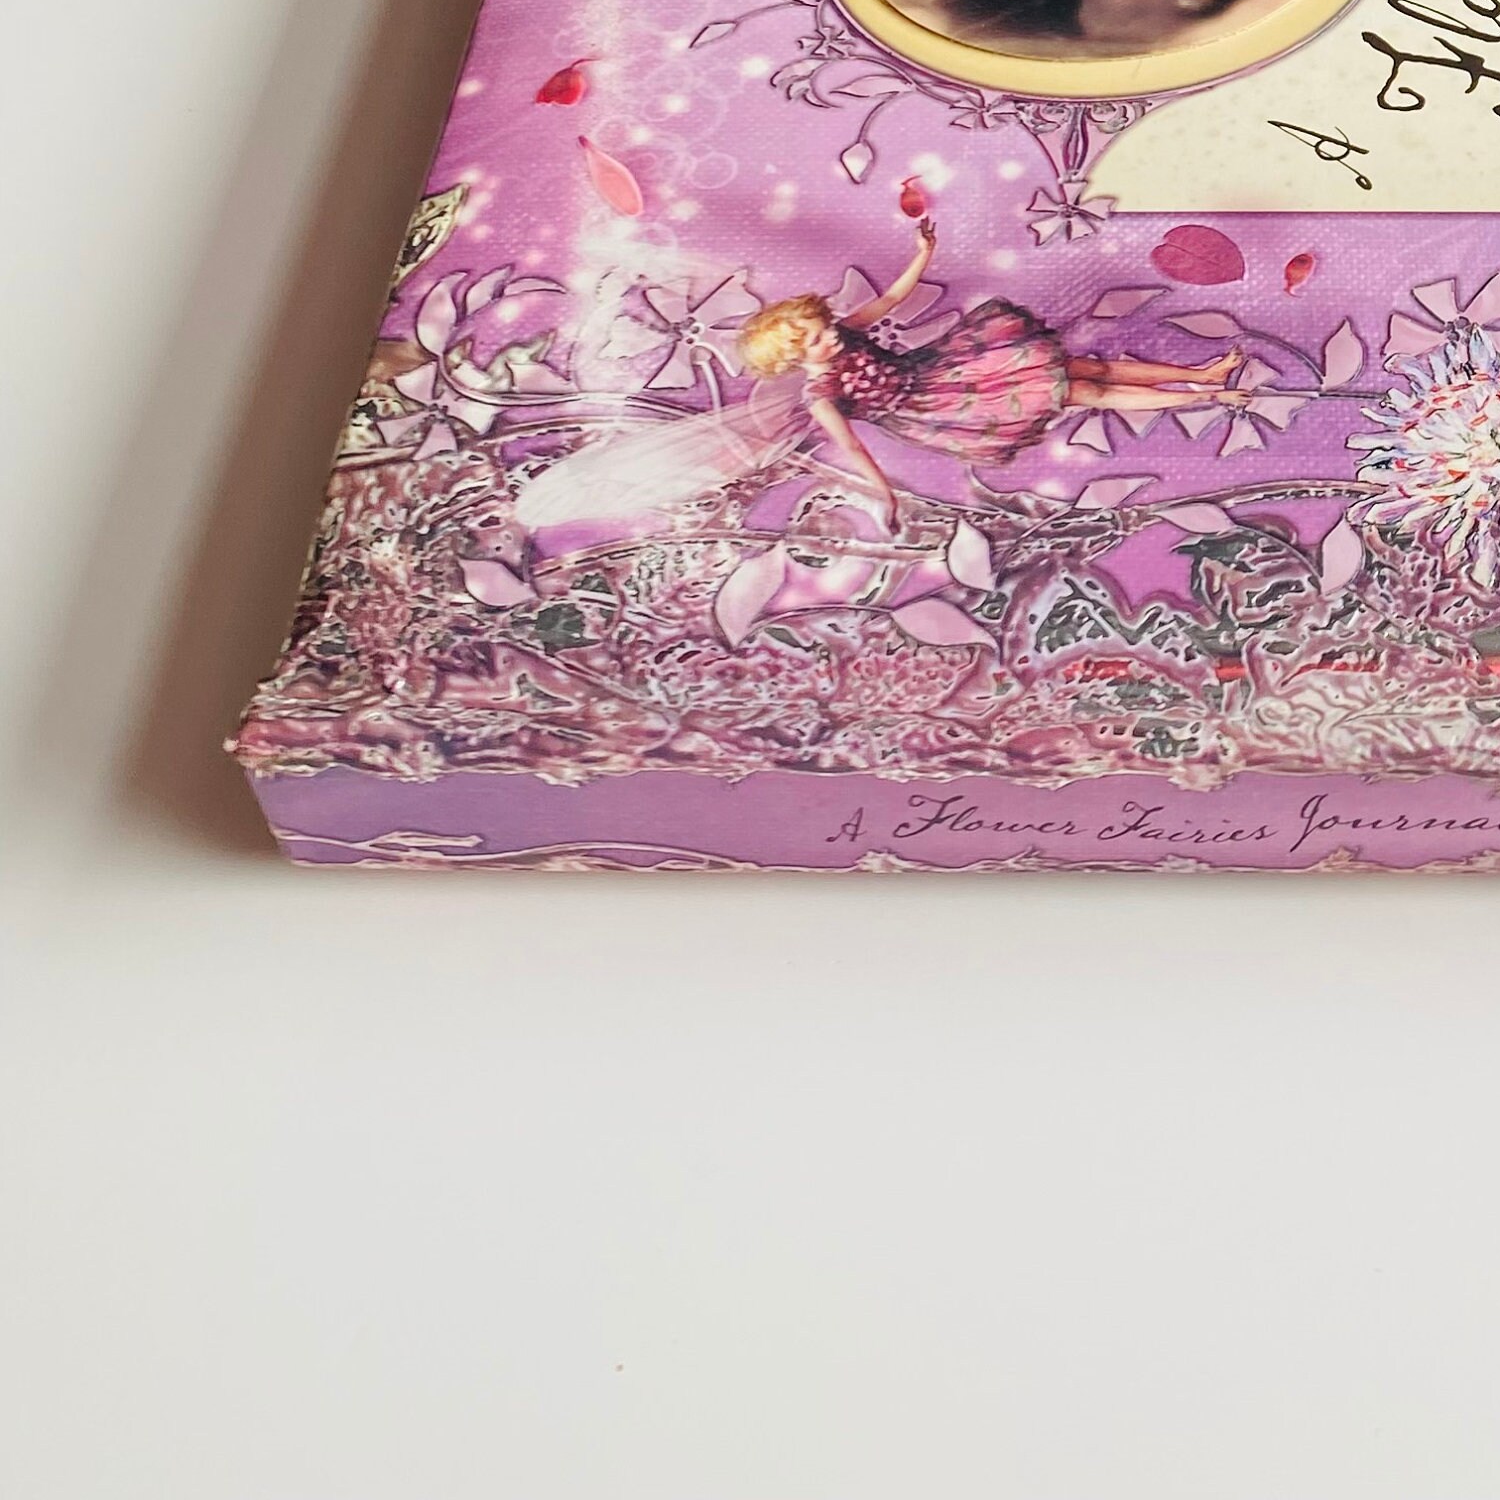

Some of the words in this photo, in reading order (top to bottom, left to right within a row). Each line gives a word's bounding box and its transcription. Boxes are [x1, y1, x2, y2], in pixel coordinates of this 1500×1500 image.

[1267, 120, 1373, 191] A
[826, 806, 867, 844] A
[892, 794, 1087, 838] Flower
[1099, 800, 1279, 842] Fairies
